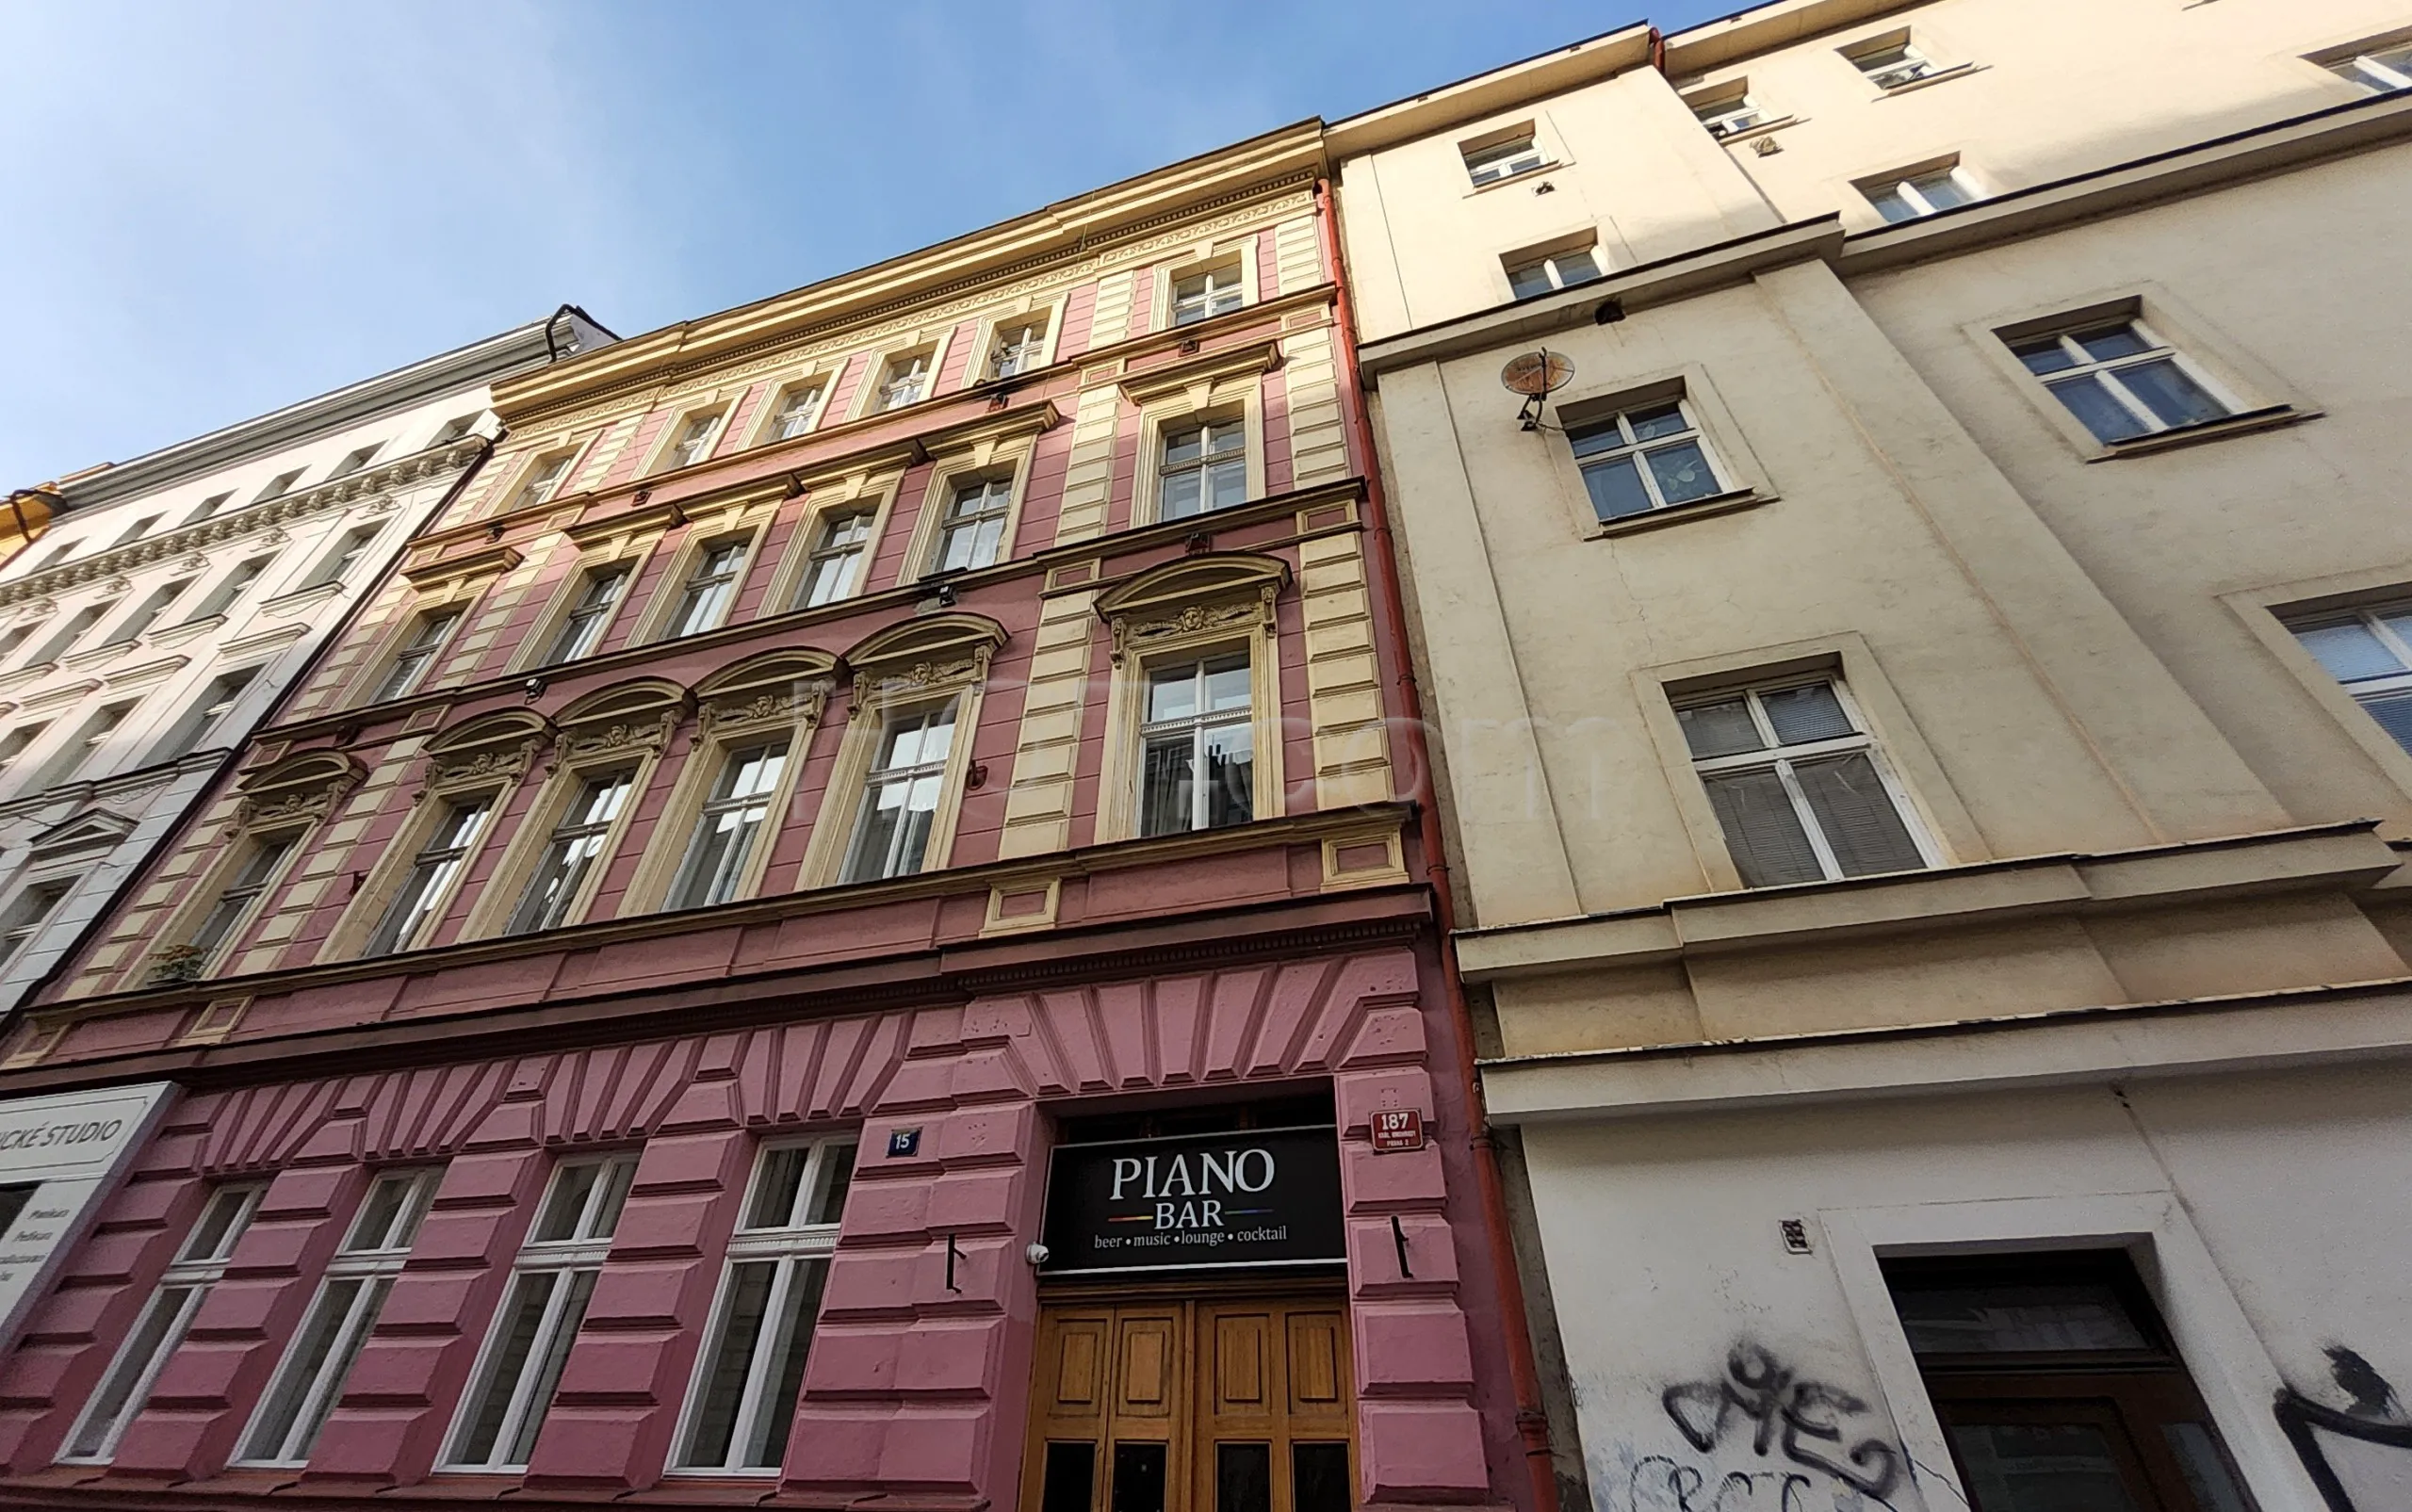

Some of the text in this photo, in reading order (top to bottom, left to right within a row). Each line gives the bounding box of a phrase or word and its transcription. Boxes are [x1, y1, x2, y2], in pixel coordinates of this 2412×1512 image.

[40, 1119, 122, 1146] STUDIO
[1381, 1113, 1409, 1130] 187
[895, 1133, 910, 1149] 15
[1109, 1148, 1275, 1200] PIANO
[1154, 1199, 1225, 1230] BAR
[1094, 1226, 1287, 1249] beer music lounge cocktail
